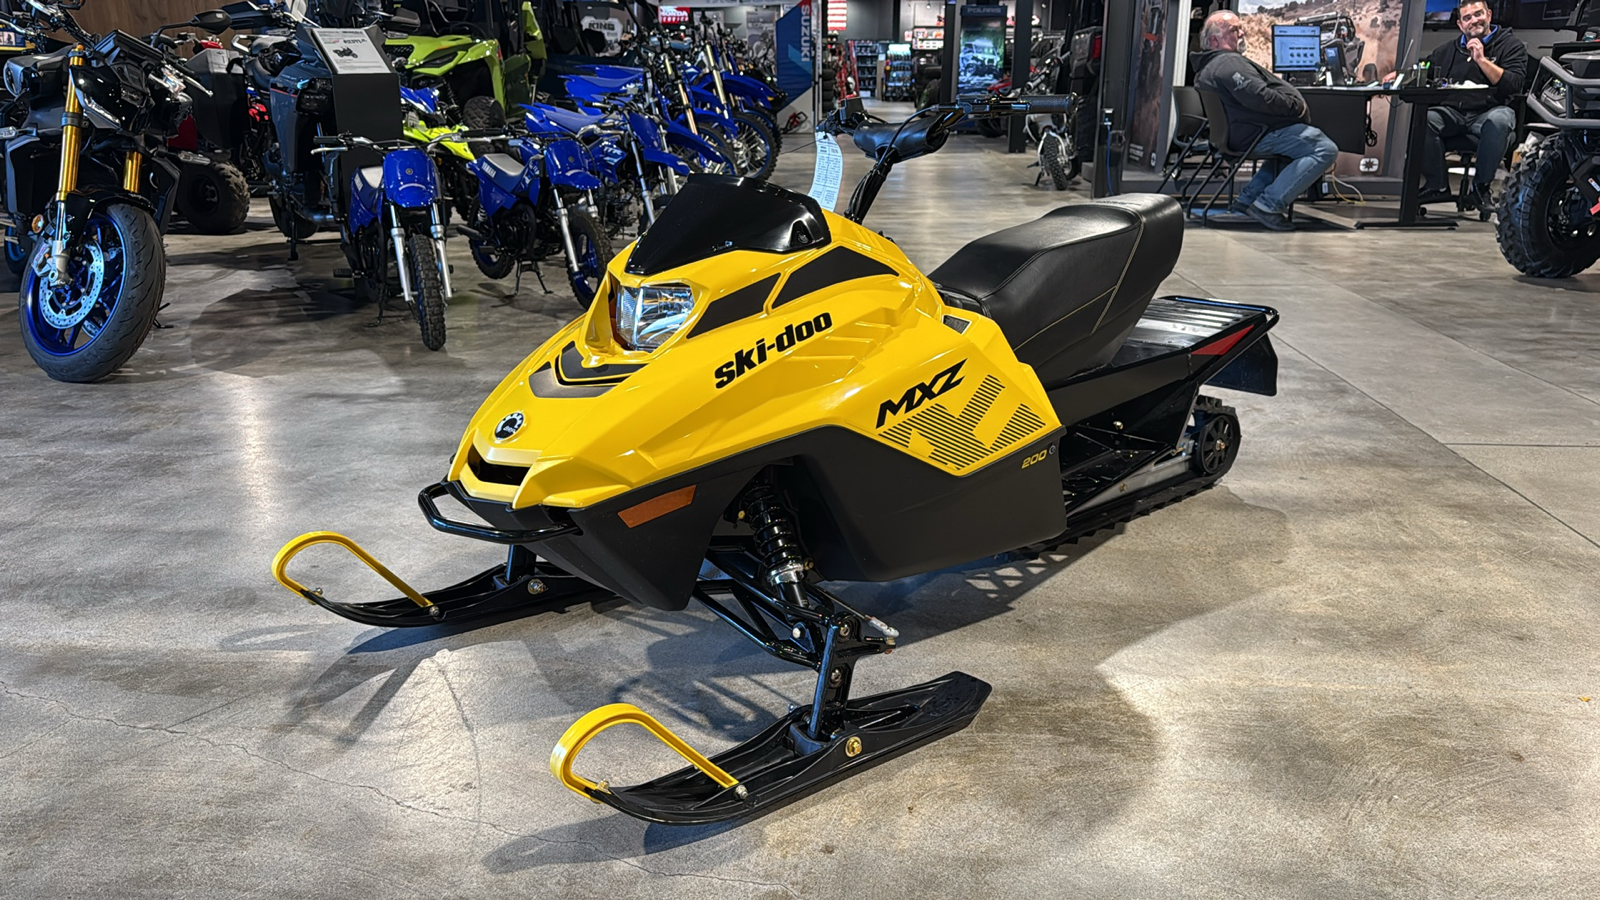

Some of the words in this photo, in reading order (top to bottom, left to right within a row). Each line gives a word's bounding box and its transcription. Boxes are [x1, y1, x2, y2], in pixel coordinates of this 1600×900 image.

[588, 22, 615, 31] KING
[801, 4, 811, 62] SUZUKI
[481, 161, 497, 178] YAMAHA
[713, 311, 833, 389] ski-doo
[875, 358, 969, 430] MXZ
[1021, 449, 1048, 470] 200
